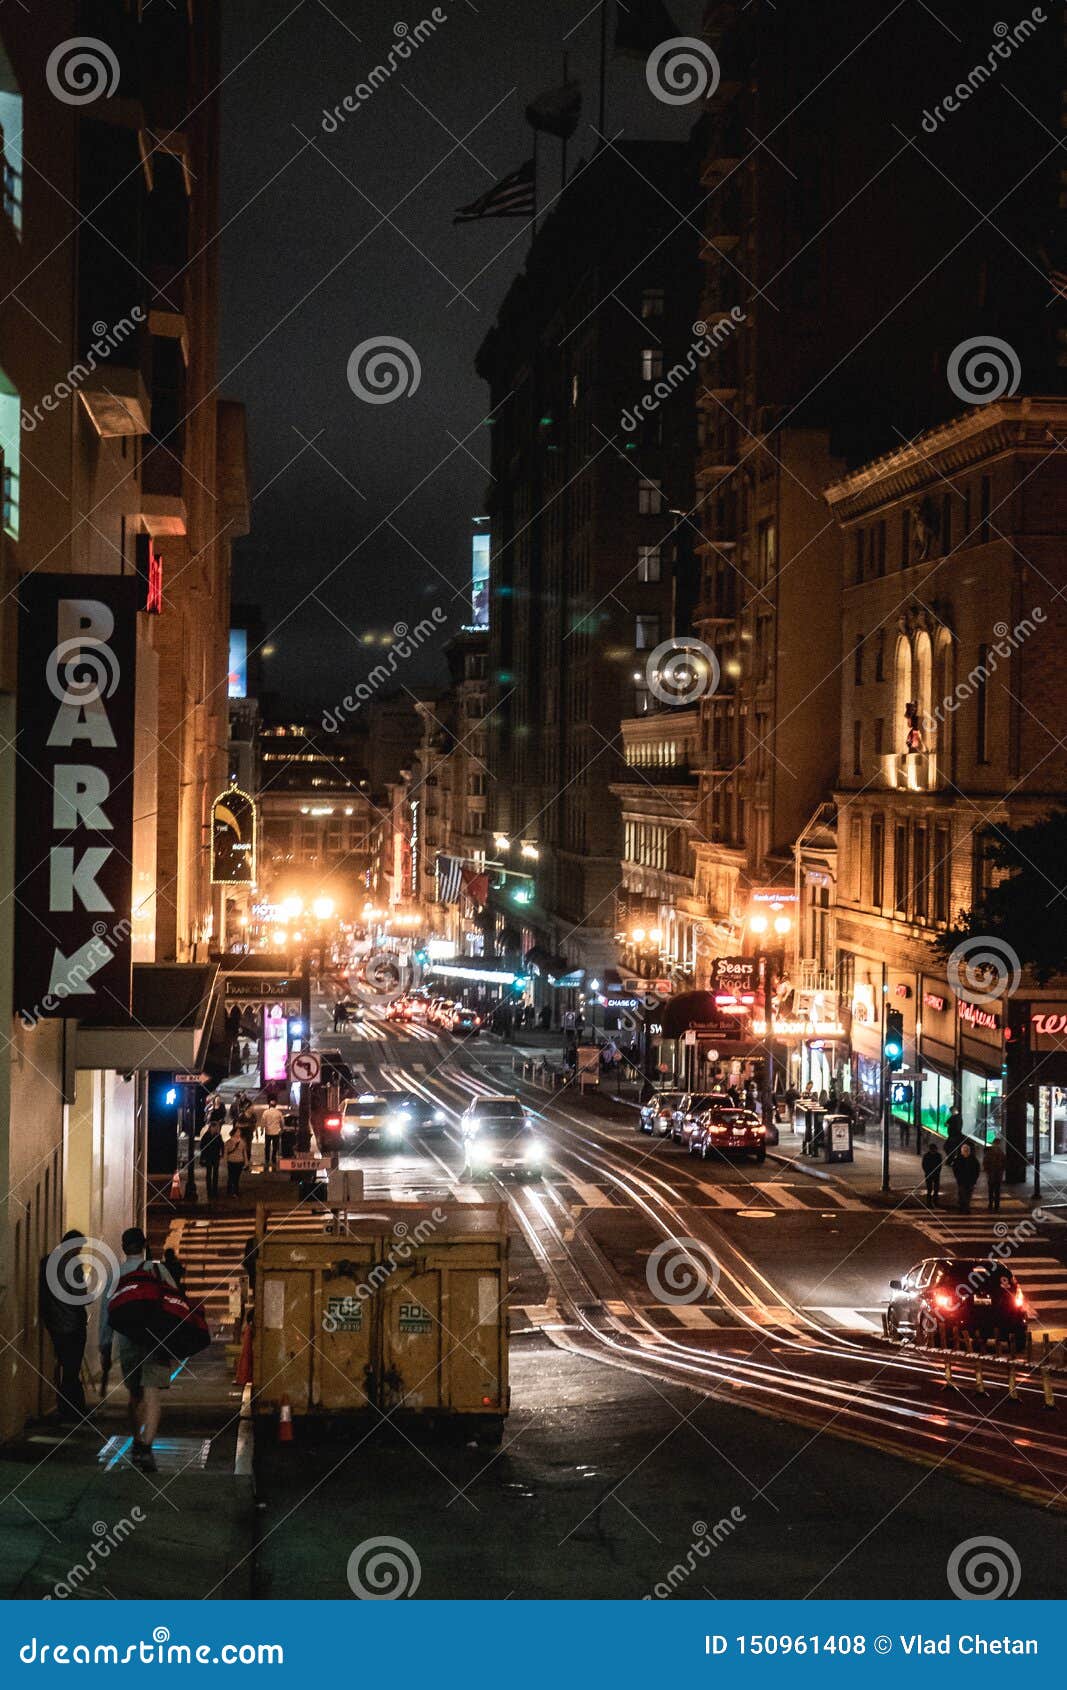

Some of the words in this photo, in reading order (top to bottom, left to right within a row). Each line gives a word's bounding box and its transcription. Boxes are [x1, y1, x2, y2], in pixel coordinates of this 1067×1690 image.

[46, 600, 117, 912] PARK
[717, 960, 753, 974] Sears
[958, 1000, 997, 1029] Walgreens
